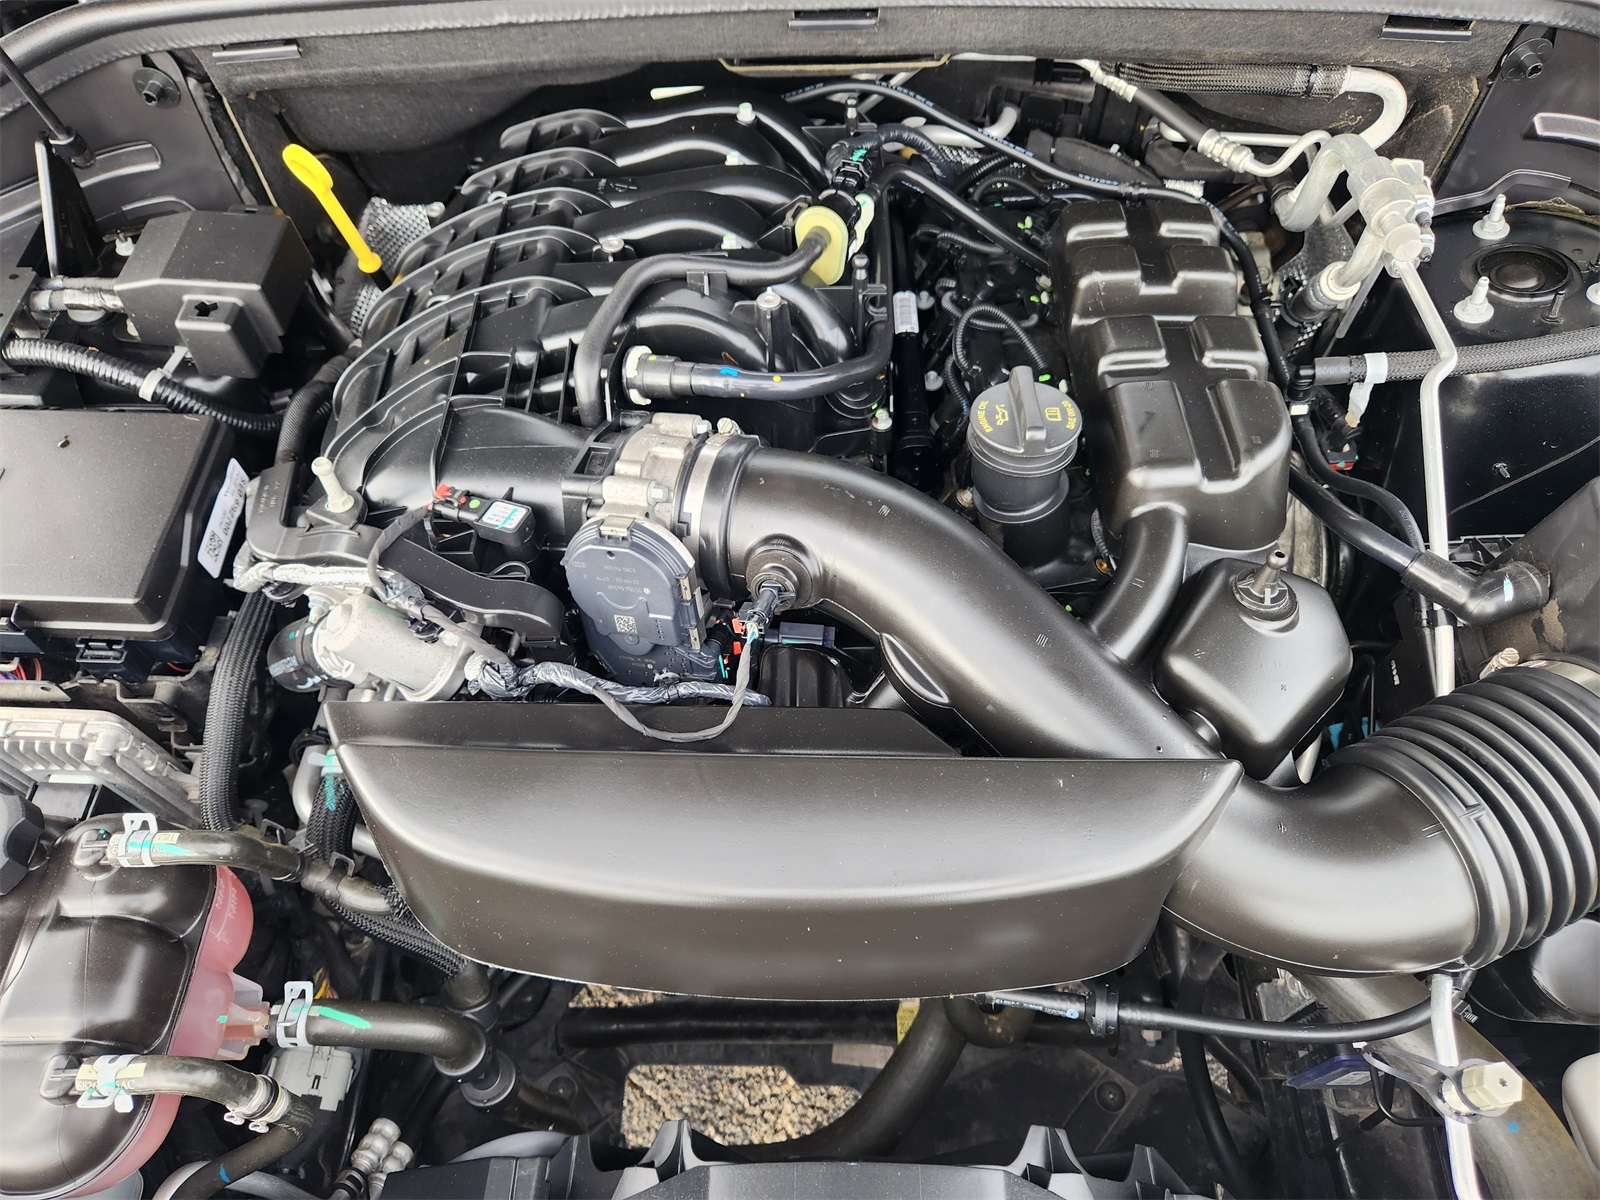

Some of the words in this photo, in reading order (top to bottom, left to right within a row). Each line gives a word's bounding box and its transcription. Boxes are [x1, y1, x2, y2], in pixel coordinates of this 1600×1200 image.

[978, 400, 989, 410] OIL
[977, 410, 993, 432] ENGINE
[1066, 417, 1076, 430] SAE
